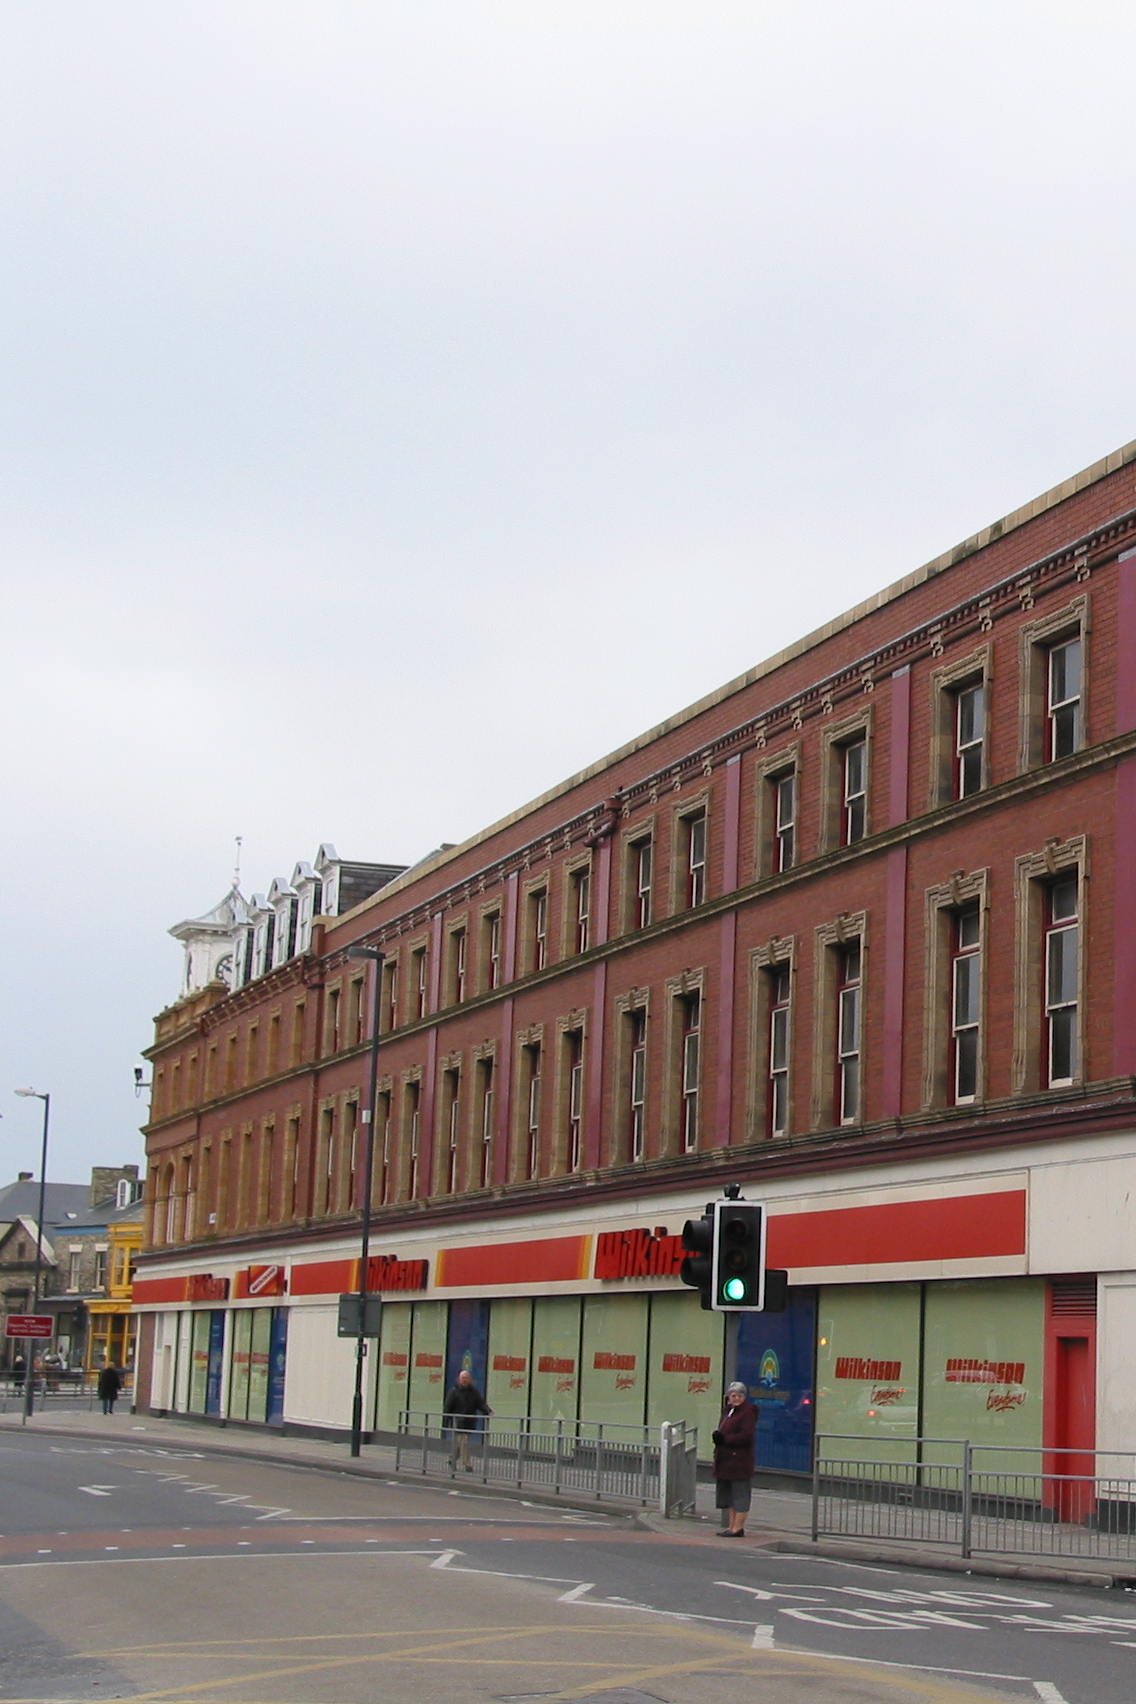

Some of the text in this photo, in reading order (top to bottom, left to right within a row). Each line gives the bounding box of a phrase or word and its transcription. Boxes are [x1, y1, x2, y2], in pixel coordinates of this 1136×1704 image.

[595, 1227, 702, 1279] Wilkins
[835, 1357, 901, 1381] Wilkinson
[945, 1358, 1025, 1384] Wilkinson
